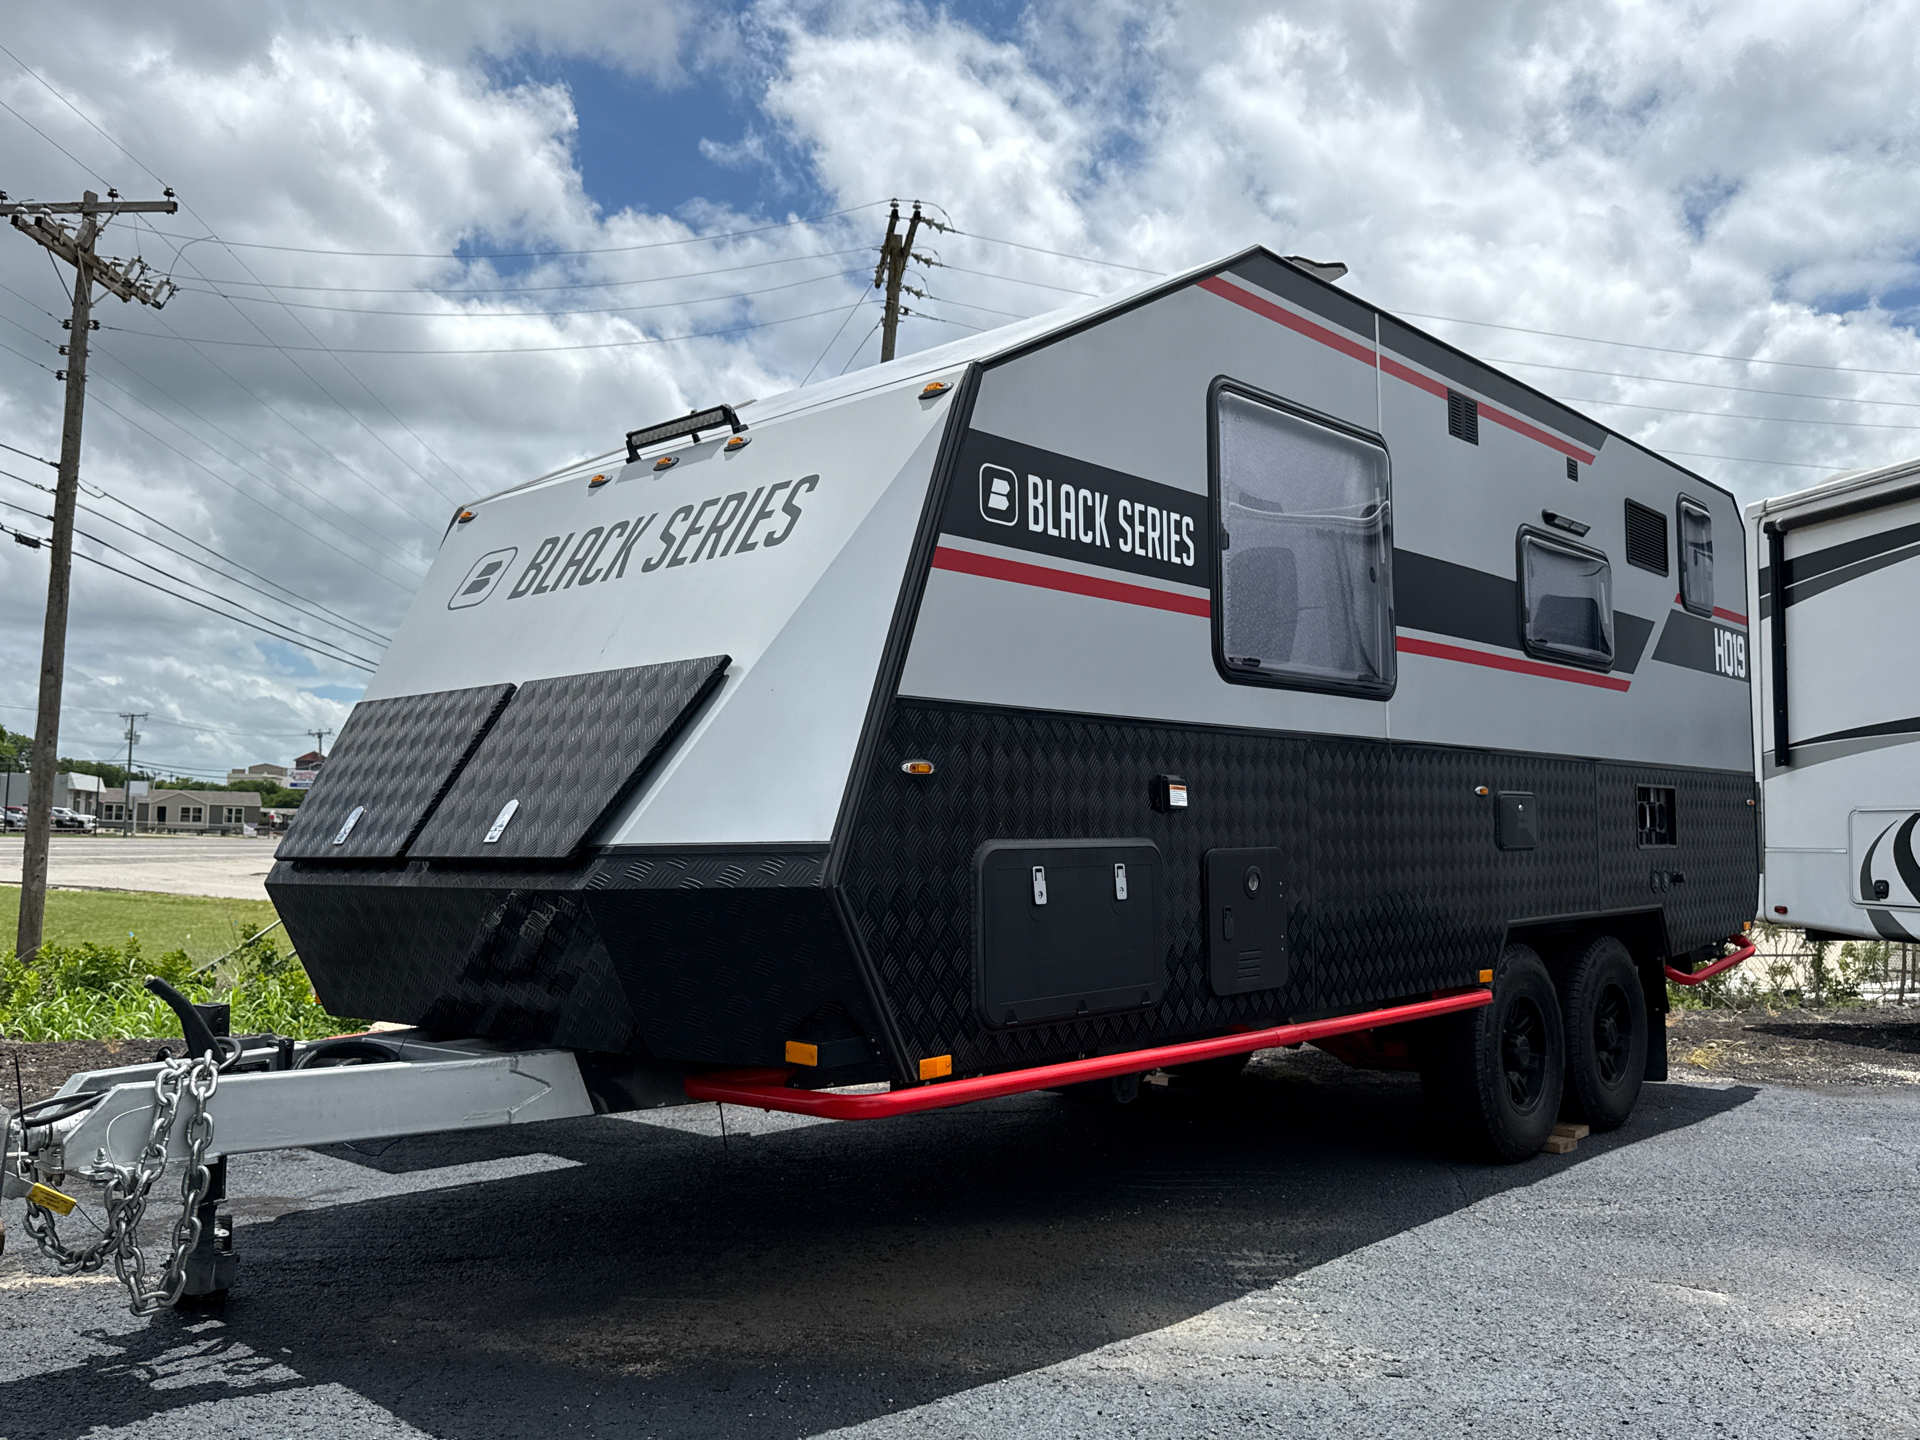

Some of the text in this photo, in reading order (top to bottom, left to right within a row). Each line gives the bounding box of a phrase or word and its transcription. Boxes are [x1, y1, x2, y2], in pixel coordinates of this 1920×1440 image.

[506, 512, 659, 601] BLACK
[640, 473, 821, 574] SERIES
[1027, 473, 1111, 549] BLACK
[1118, 498, 1195, 567] SERIES
[1713, 627, 1746, 678] HQ19
